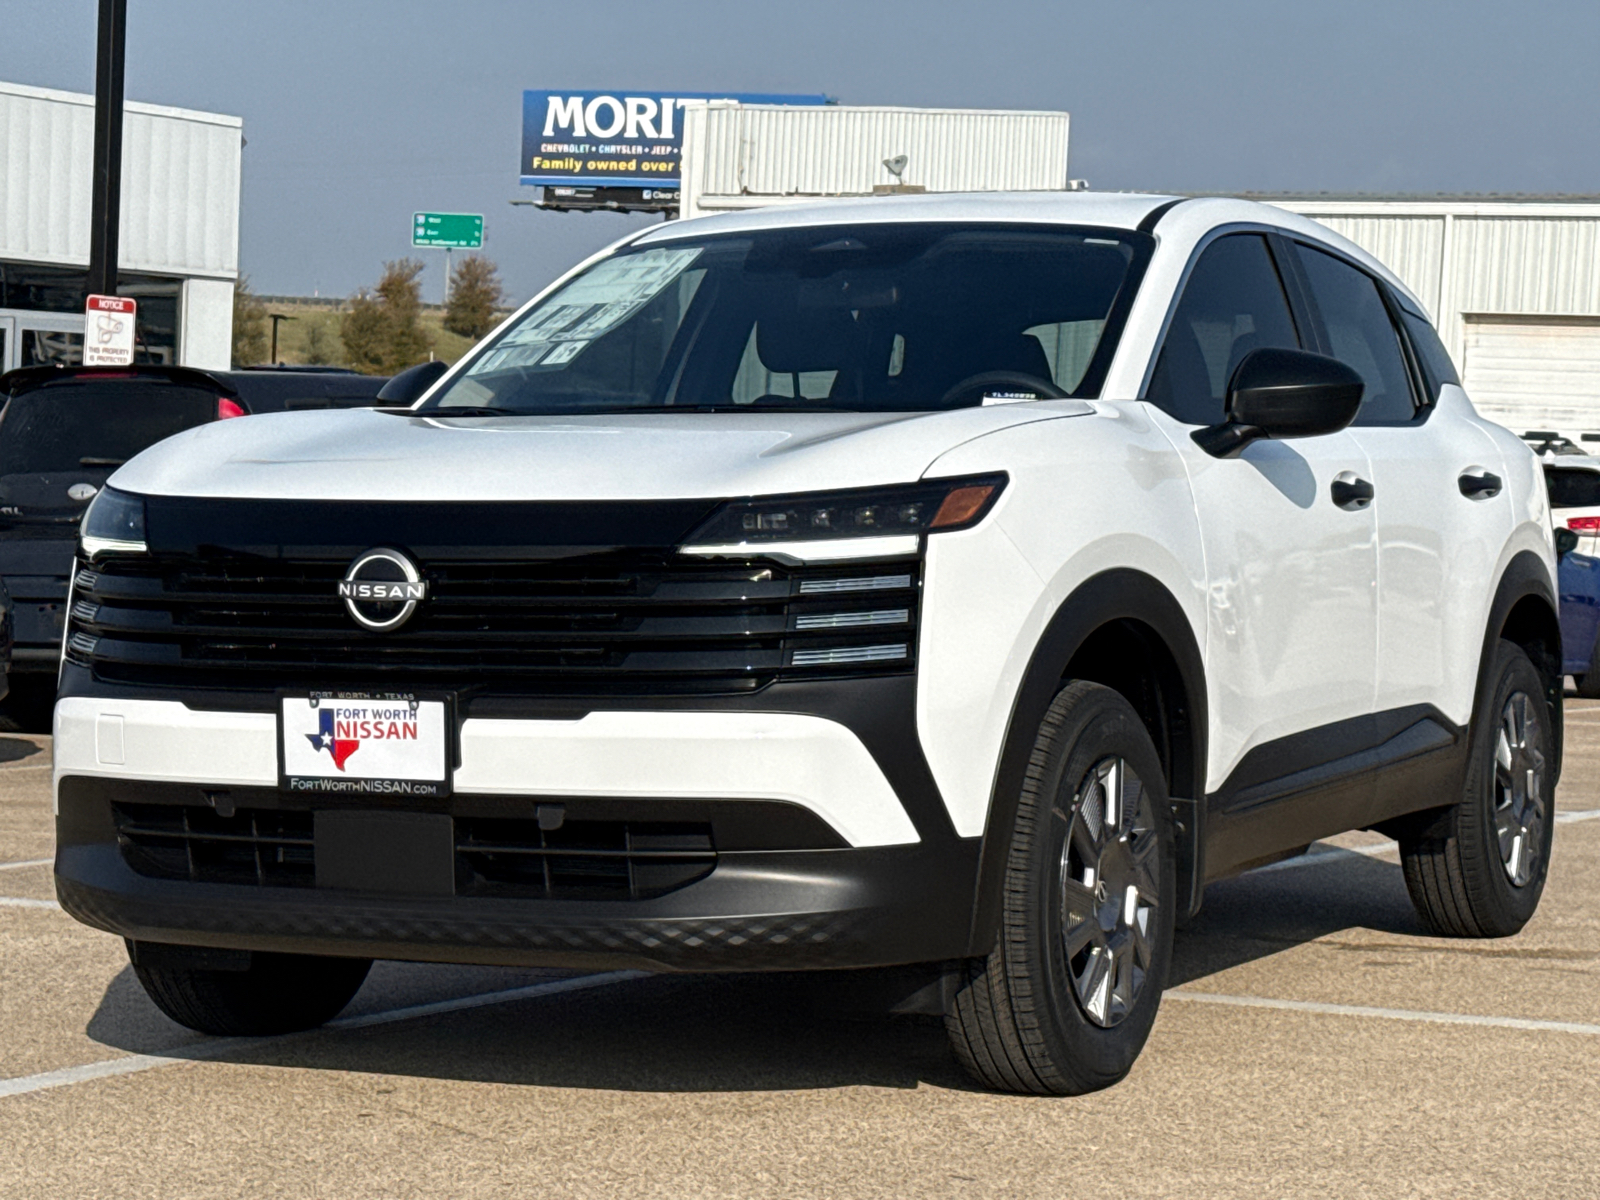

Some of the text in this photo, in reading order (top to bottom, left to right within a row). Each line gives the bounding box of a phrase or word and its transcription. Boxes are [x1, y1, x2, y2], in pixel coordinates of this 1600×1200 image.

[542, 96, 738, 138] MORI
[541, 143, 590, 154] CHEVROLET
[598, 144, 642, 155] CHRYSLER
[650, 145, 672, 156] JEEP
[532, 157, 583, 173] Family
[586, 159, 637, 171] owned
[641, 161, 675, 172] over
[98, 299, 124, 310] NOTICE
[102, 347, 129, 356] PROPERTY
[96, 355, 128, 363] PROTECTED
[339, 582, 422, 598] NISSAN
[336, 708, 417, 721] FORT WORTH
[336, 720, 418, 740] NISSAN
